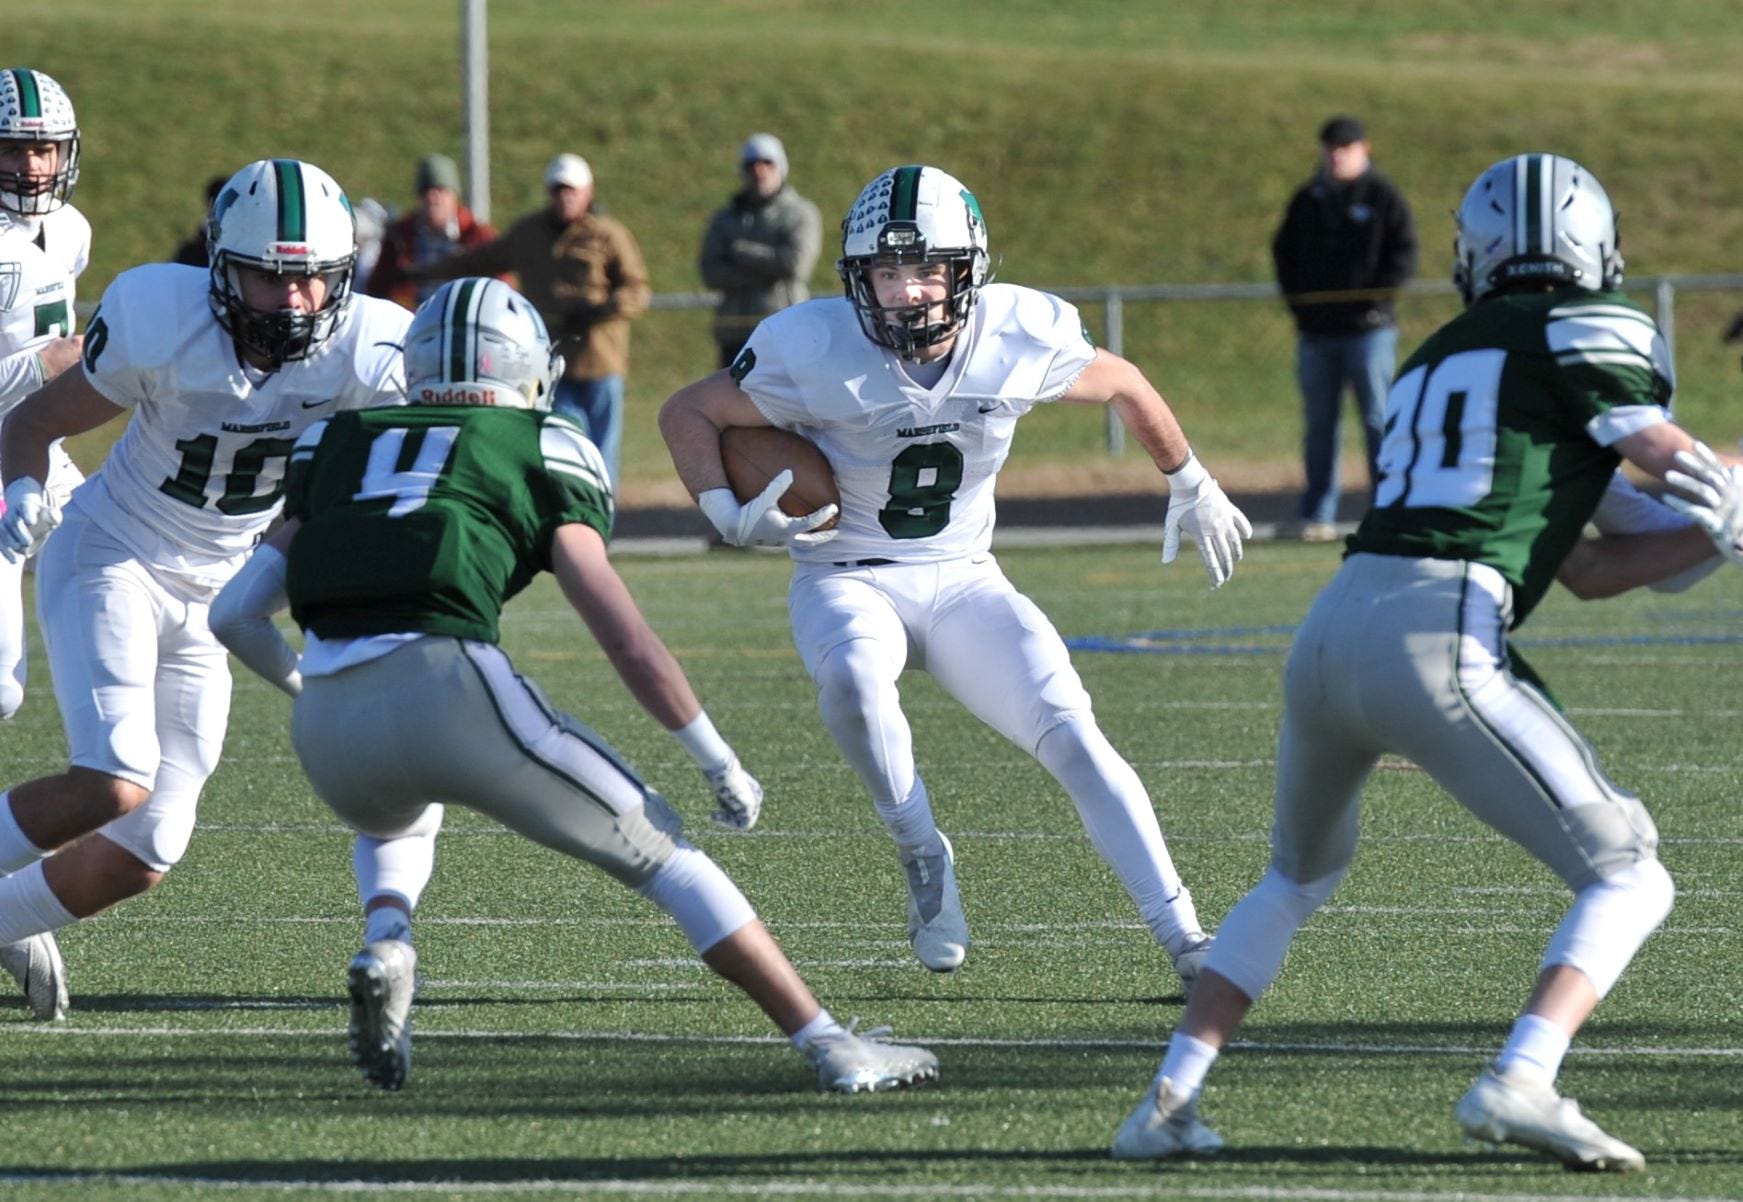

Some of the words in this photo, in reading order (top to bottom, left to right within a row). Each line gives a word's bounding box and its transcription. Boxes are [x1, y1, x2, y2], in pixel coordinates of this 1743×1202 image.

[159, 433, 298, 516] 10
[352, 426, 460, 517] 4
[878, 441, 964, 539] 8
